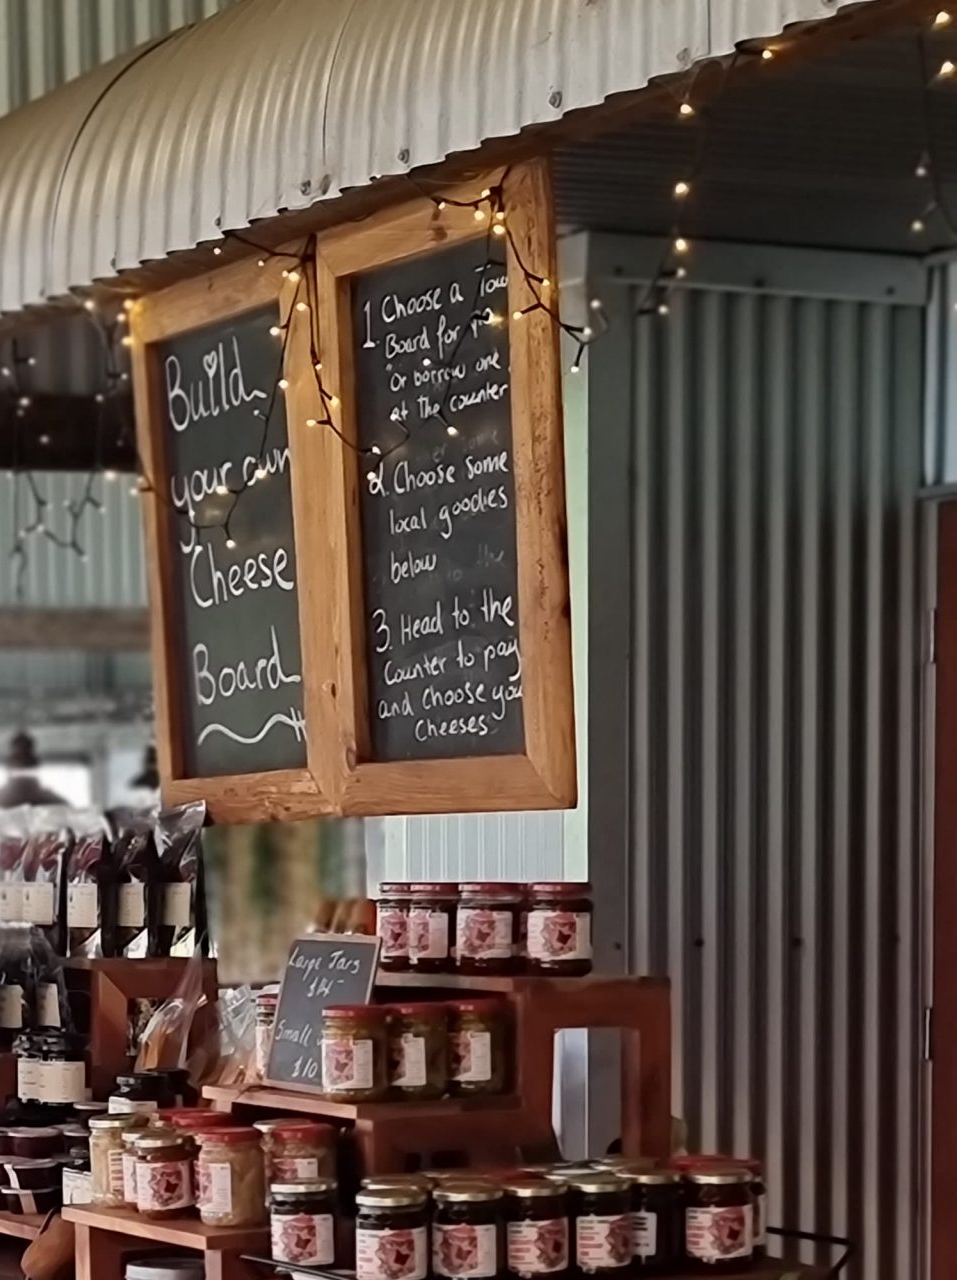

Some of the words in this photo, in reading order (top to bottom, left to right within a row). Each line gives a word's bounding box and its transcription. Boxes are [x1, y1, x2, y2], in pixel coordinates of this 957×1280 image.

[382, 287, 442, 323] Choose
[450, 283, 464, 304] a
[385, 326, 431, 358] Board
[436, 314, 460, 359] for
[165, 336, 267, 431] Build
[414, 364, 466, 387] borrow
[475, 348, 502, 372] one
[390, 400, 409, 421] at
[393, 460, 455, 494] Choose
[171, 462, 232, 553] your
[389, 507, 427, 535] local
[439, 486, 508, 540] goodies
[191, 542, 294, 608] Cheese
[390, 550, 437, 584] below
[401, 601, 443, 646] Head
[452, 595, 470, 629] to
[480, 587, 515, 627] the
[193, 624, 302, 706] Board
[456, 639, 475, 668] to
[483, 638, 522, 682] pay
[378, 691, 414, 719] and
[275, 1019, 312, 1047] Small
[291, 1055, 318, 1078] $10
